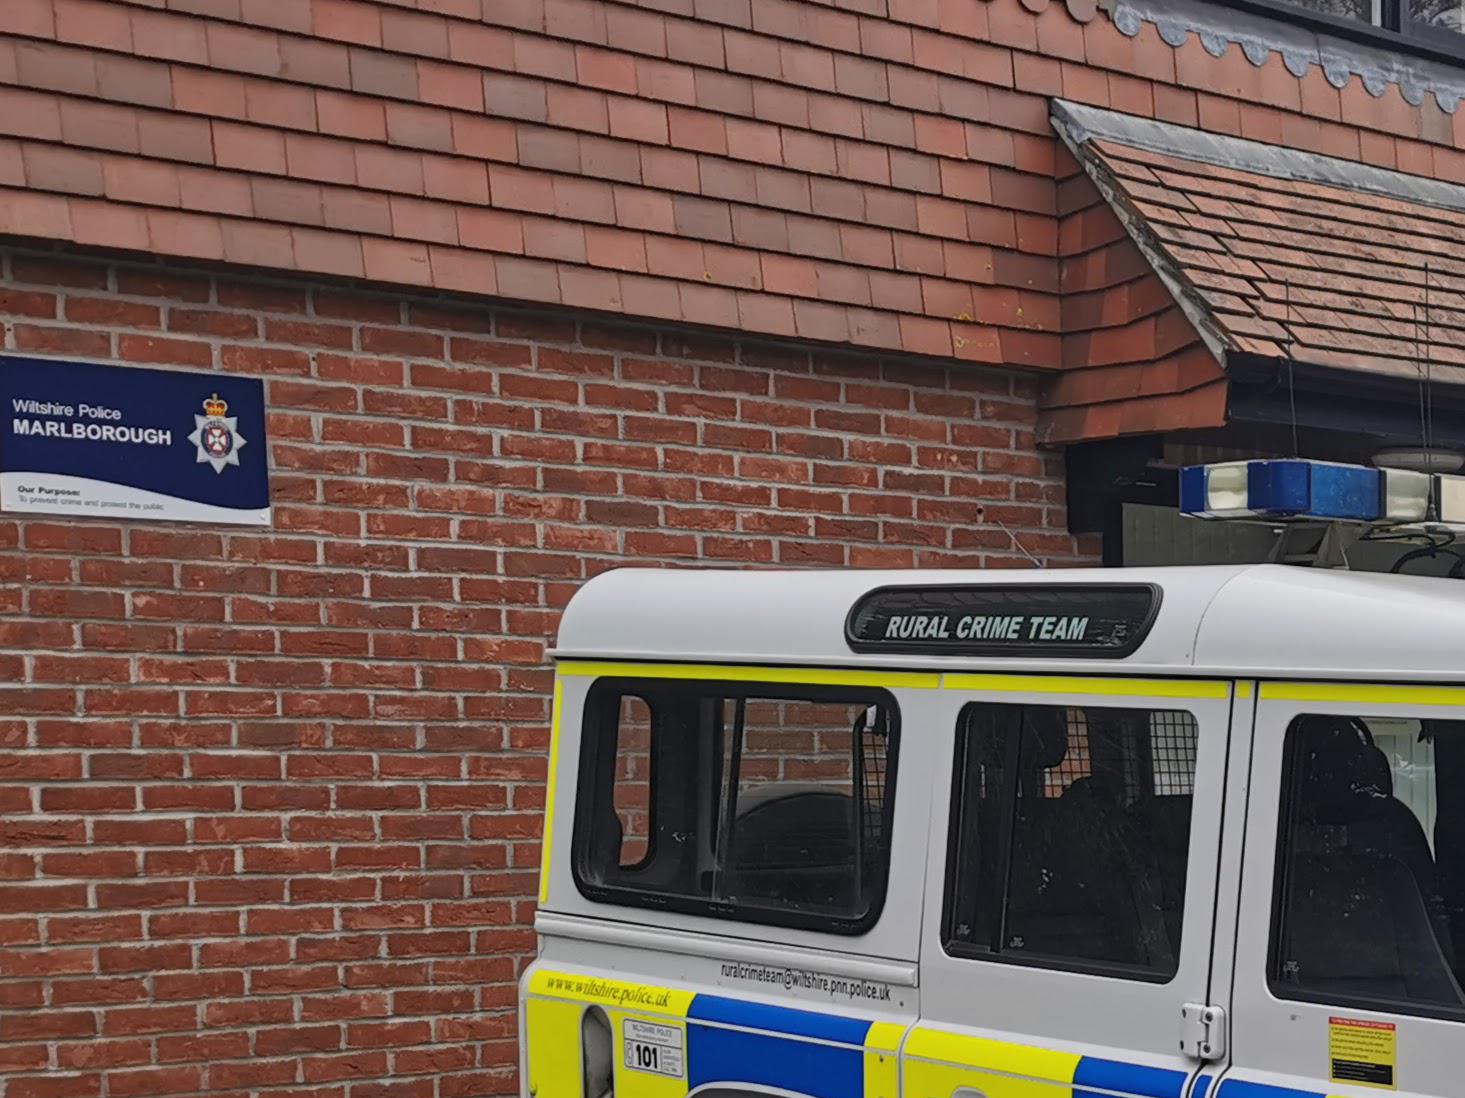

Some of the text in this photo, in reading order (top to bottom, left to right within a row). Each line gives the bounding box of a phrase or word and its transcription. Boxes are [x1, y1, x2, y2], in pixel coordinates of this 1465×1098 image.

[13, 399, 122, 421] Wiltshire Police
[13, 418, 172, 445] MARLBOROUGH
[17, 485, 35, 494] Our
[885, 615, 1089, 641] RURAL CRIME TEAM
[547, 977, 672, 1007] www.wiltshire.police.uk
[721, 962, 891, 1001] ruralcrimeteam@wiltshire.pnn.police.uk
[636, 1043, 658, 1069] 101
